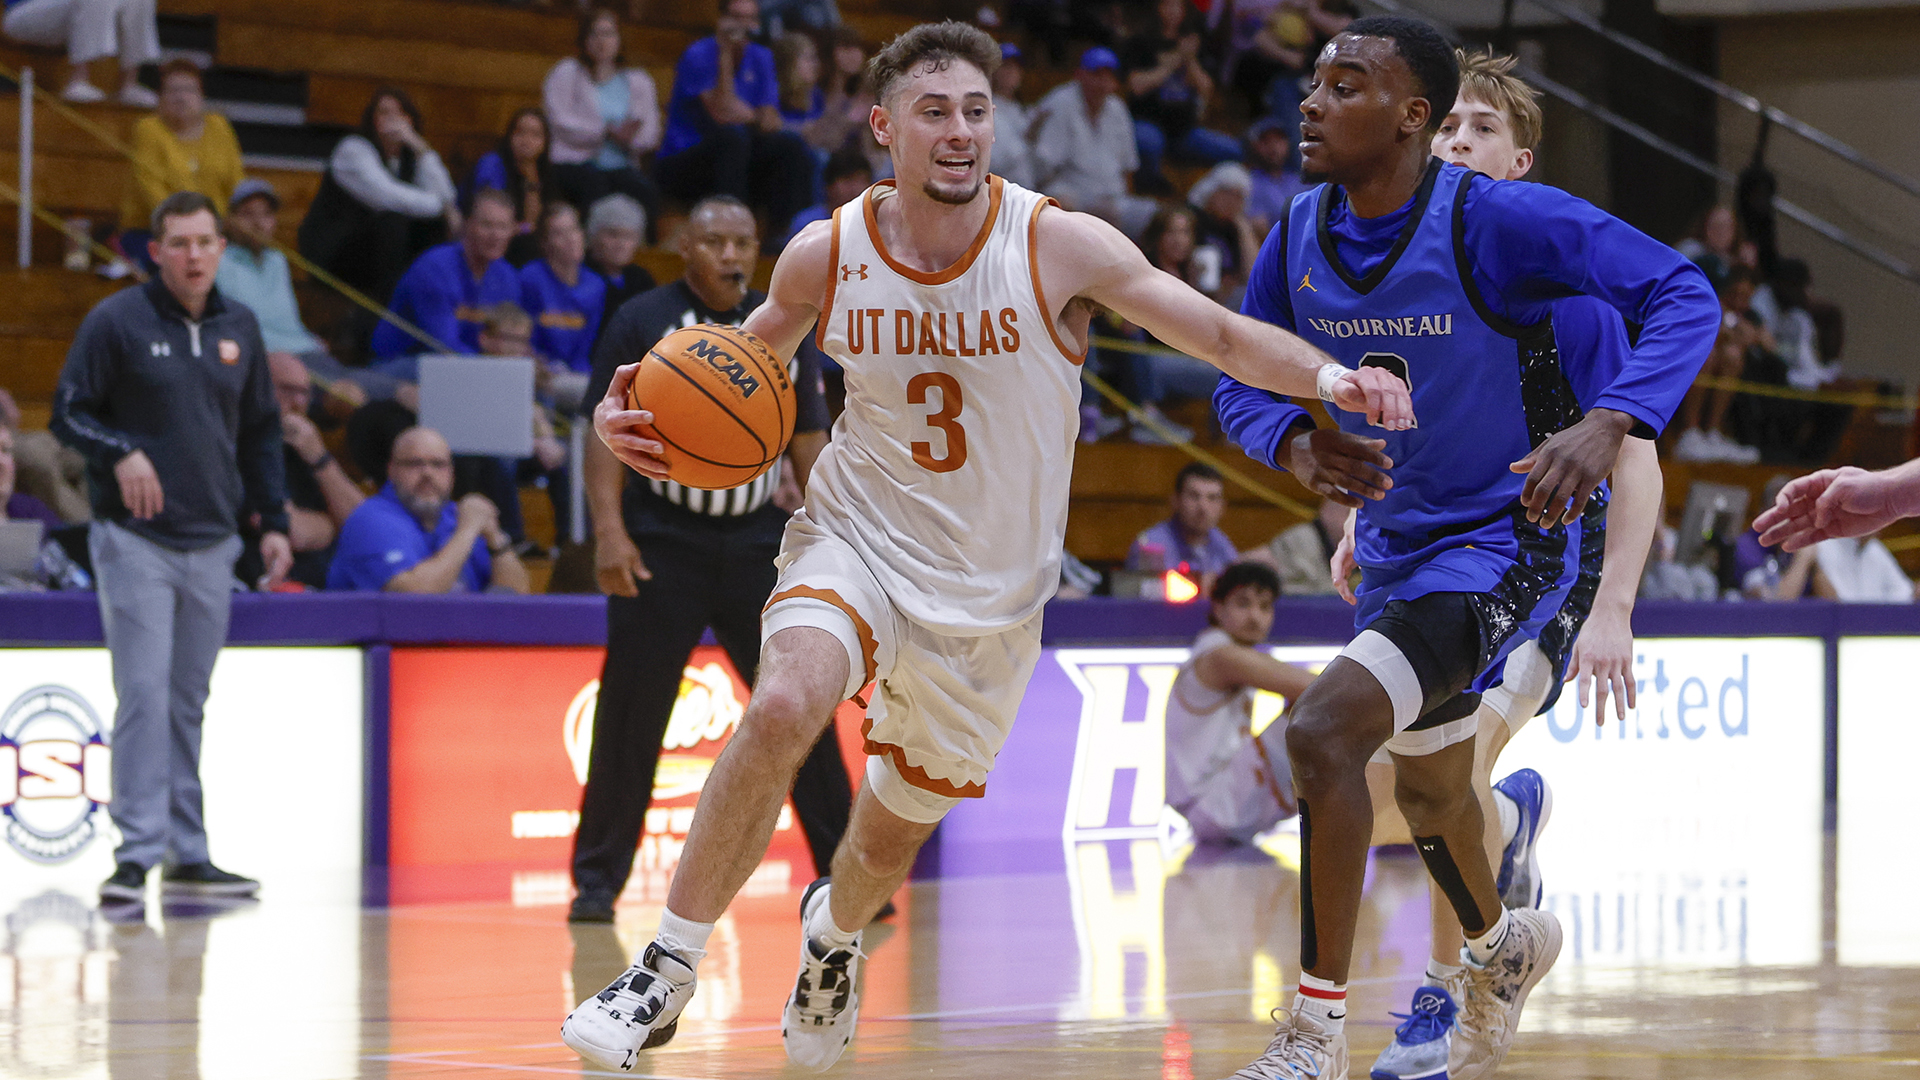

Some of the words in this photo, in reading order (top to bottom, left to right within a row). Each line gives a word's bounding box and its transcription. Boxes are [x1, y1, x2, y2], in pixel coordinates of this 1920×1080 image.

[847, 308, 884, 354] UT
[895, 307, 1020, 357] DALLAS
[687, 339, 761, 399] NCAA
[907, 372, 967, 473] 3
